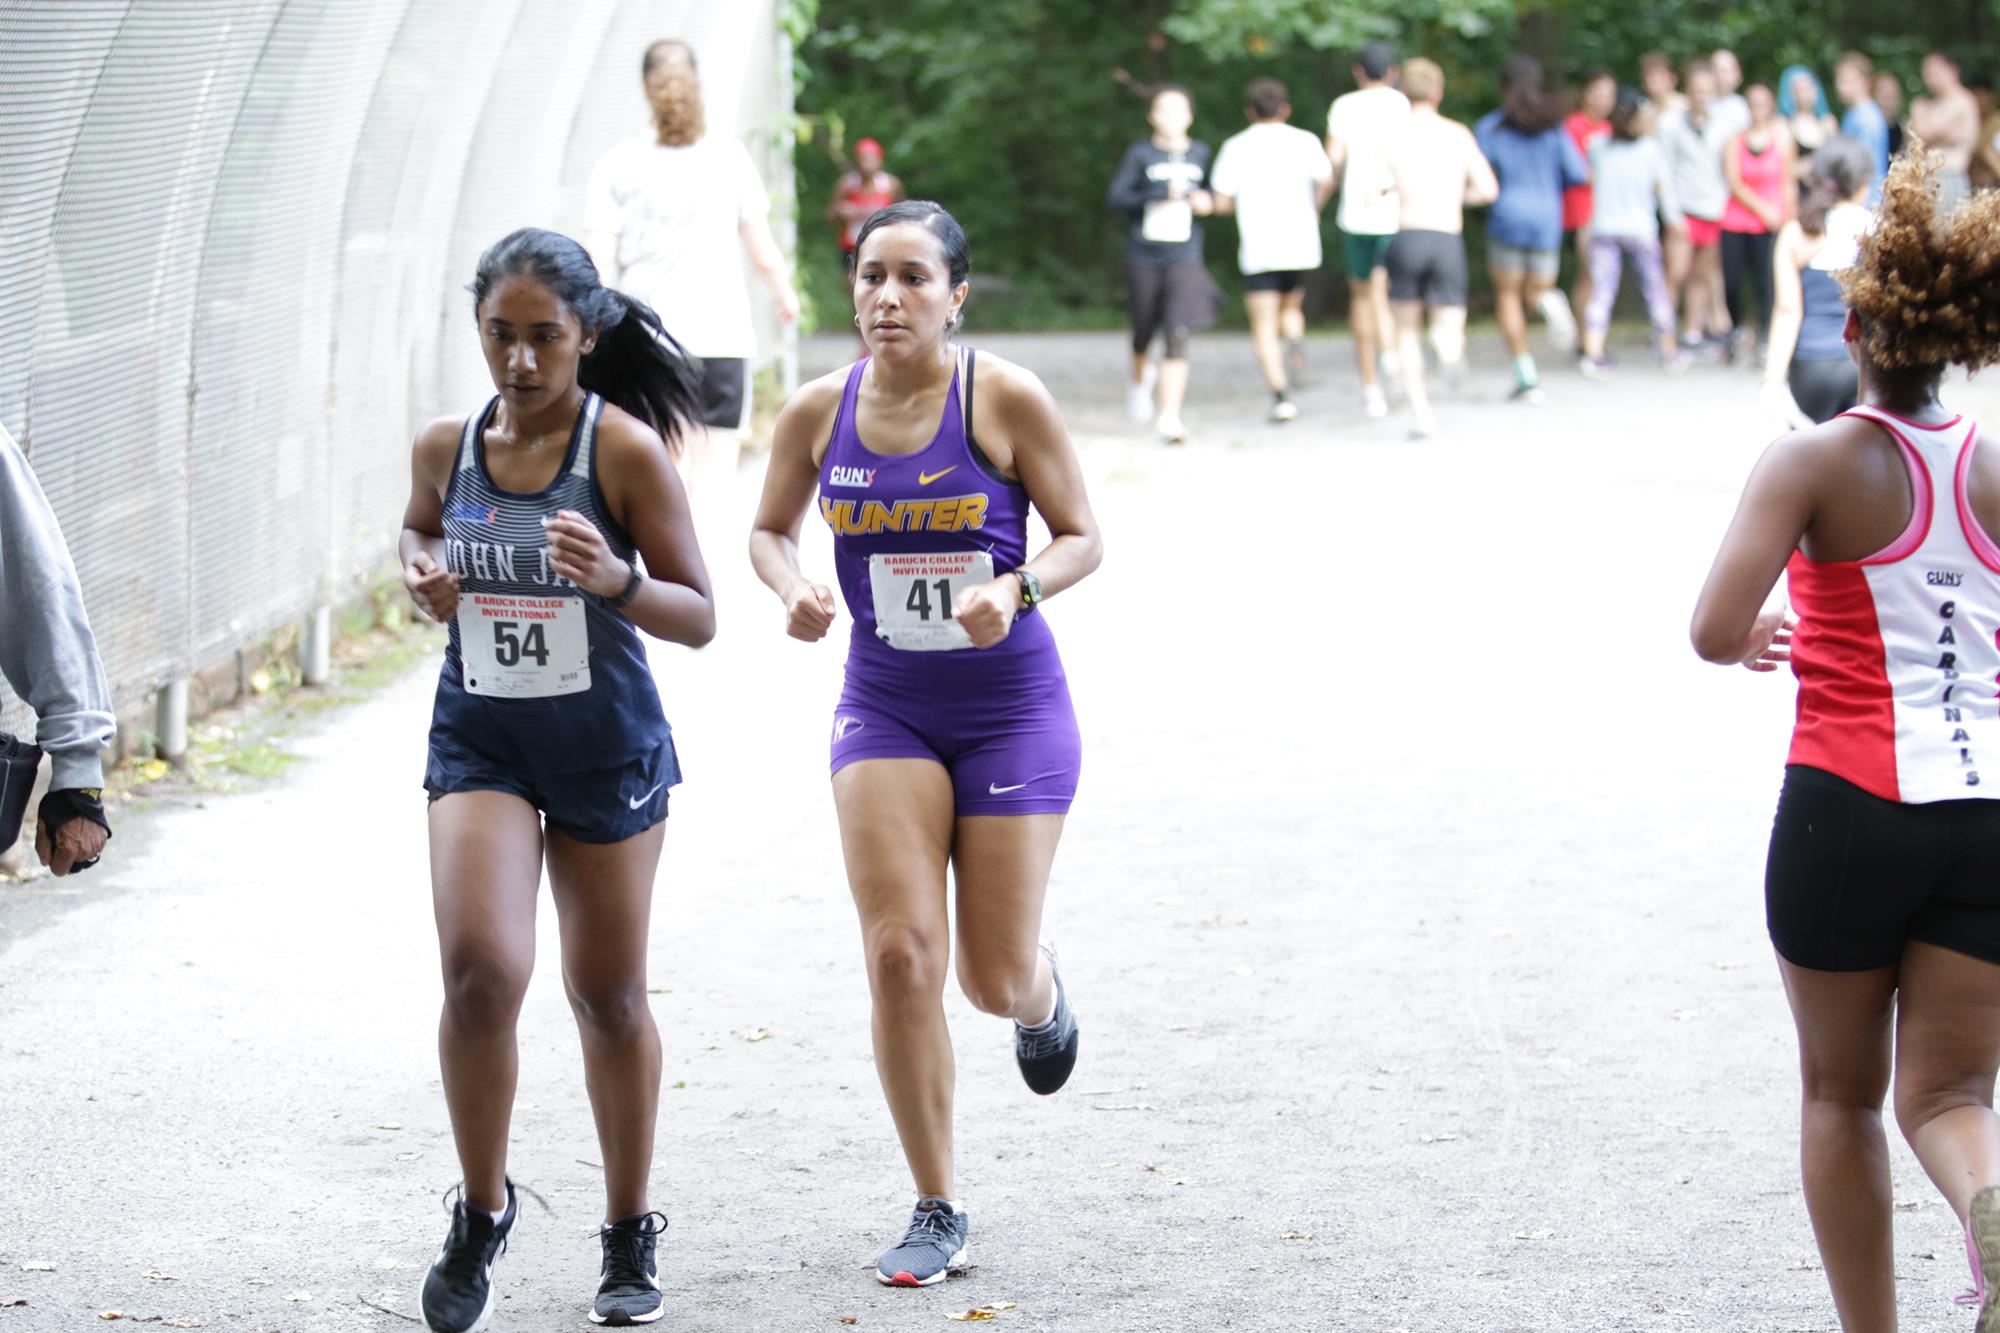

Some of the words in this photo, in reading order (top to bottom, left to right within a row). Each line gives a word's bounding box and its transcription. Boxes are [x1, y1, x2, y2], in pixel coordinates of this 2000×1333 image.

[830, 464, 877, 487] CUNY
[821, 492, 989, 536] HUNTER
[884, 556, 927, 566] BARUCH
[929, 555, 974, 564] COLLEGE
[892, 566, 967, 576] INVITATIONAL
[1927, 571, 1964, 587] CUNY
[474, 595, 516, 607] BARUCH
[519, 597, 565, 609] COLLEGE
[906, 578, 953, 621] 41
[482, 607, 557, 620] INVITATIONAL
[493, 621, 550, 667] 54
